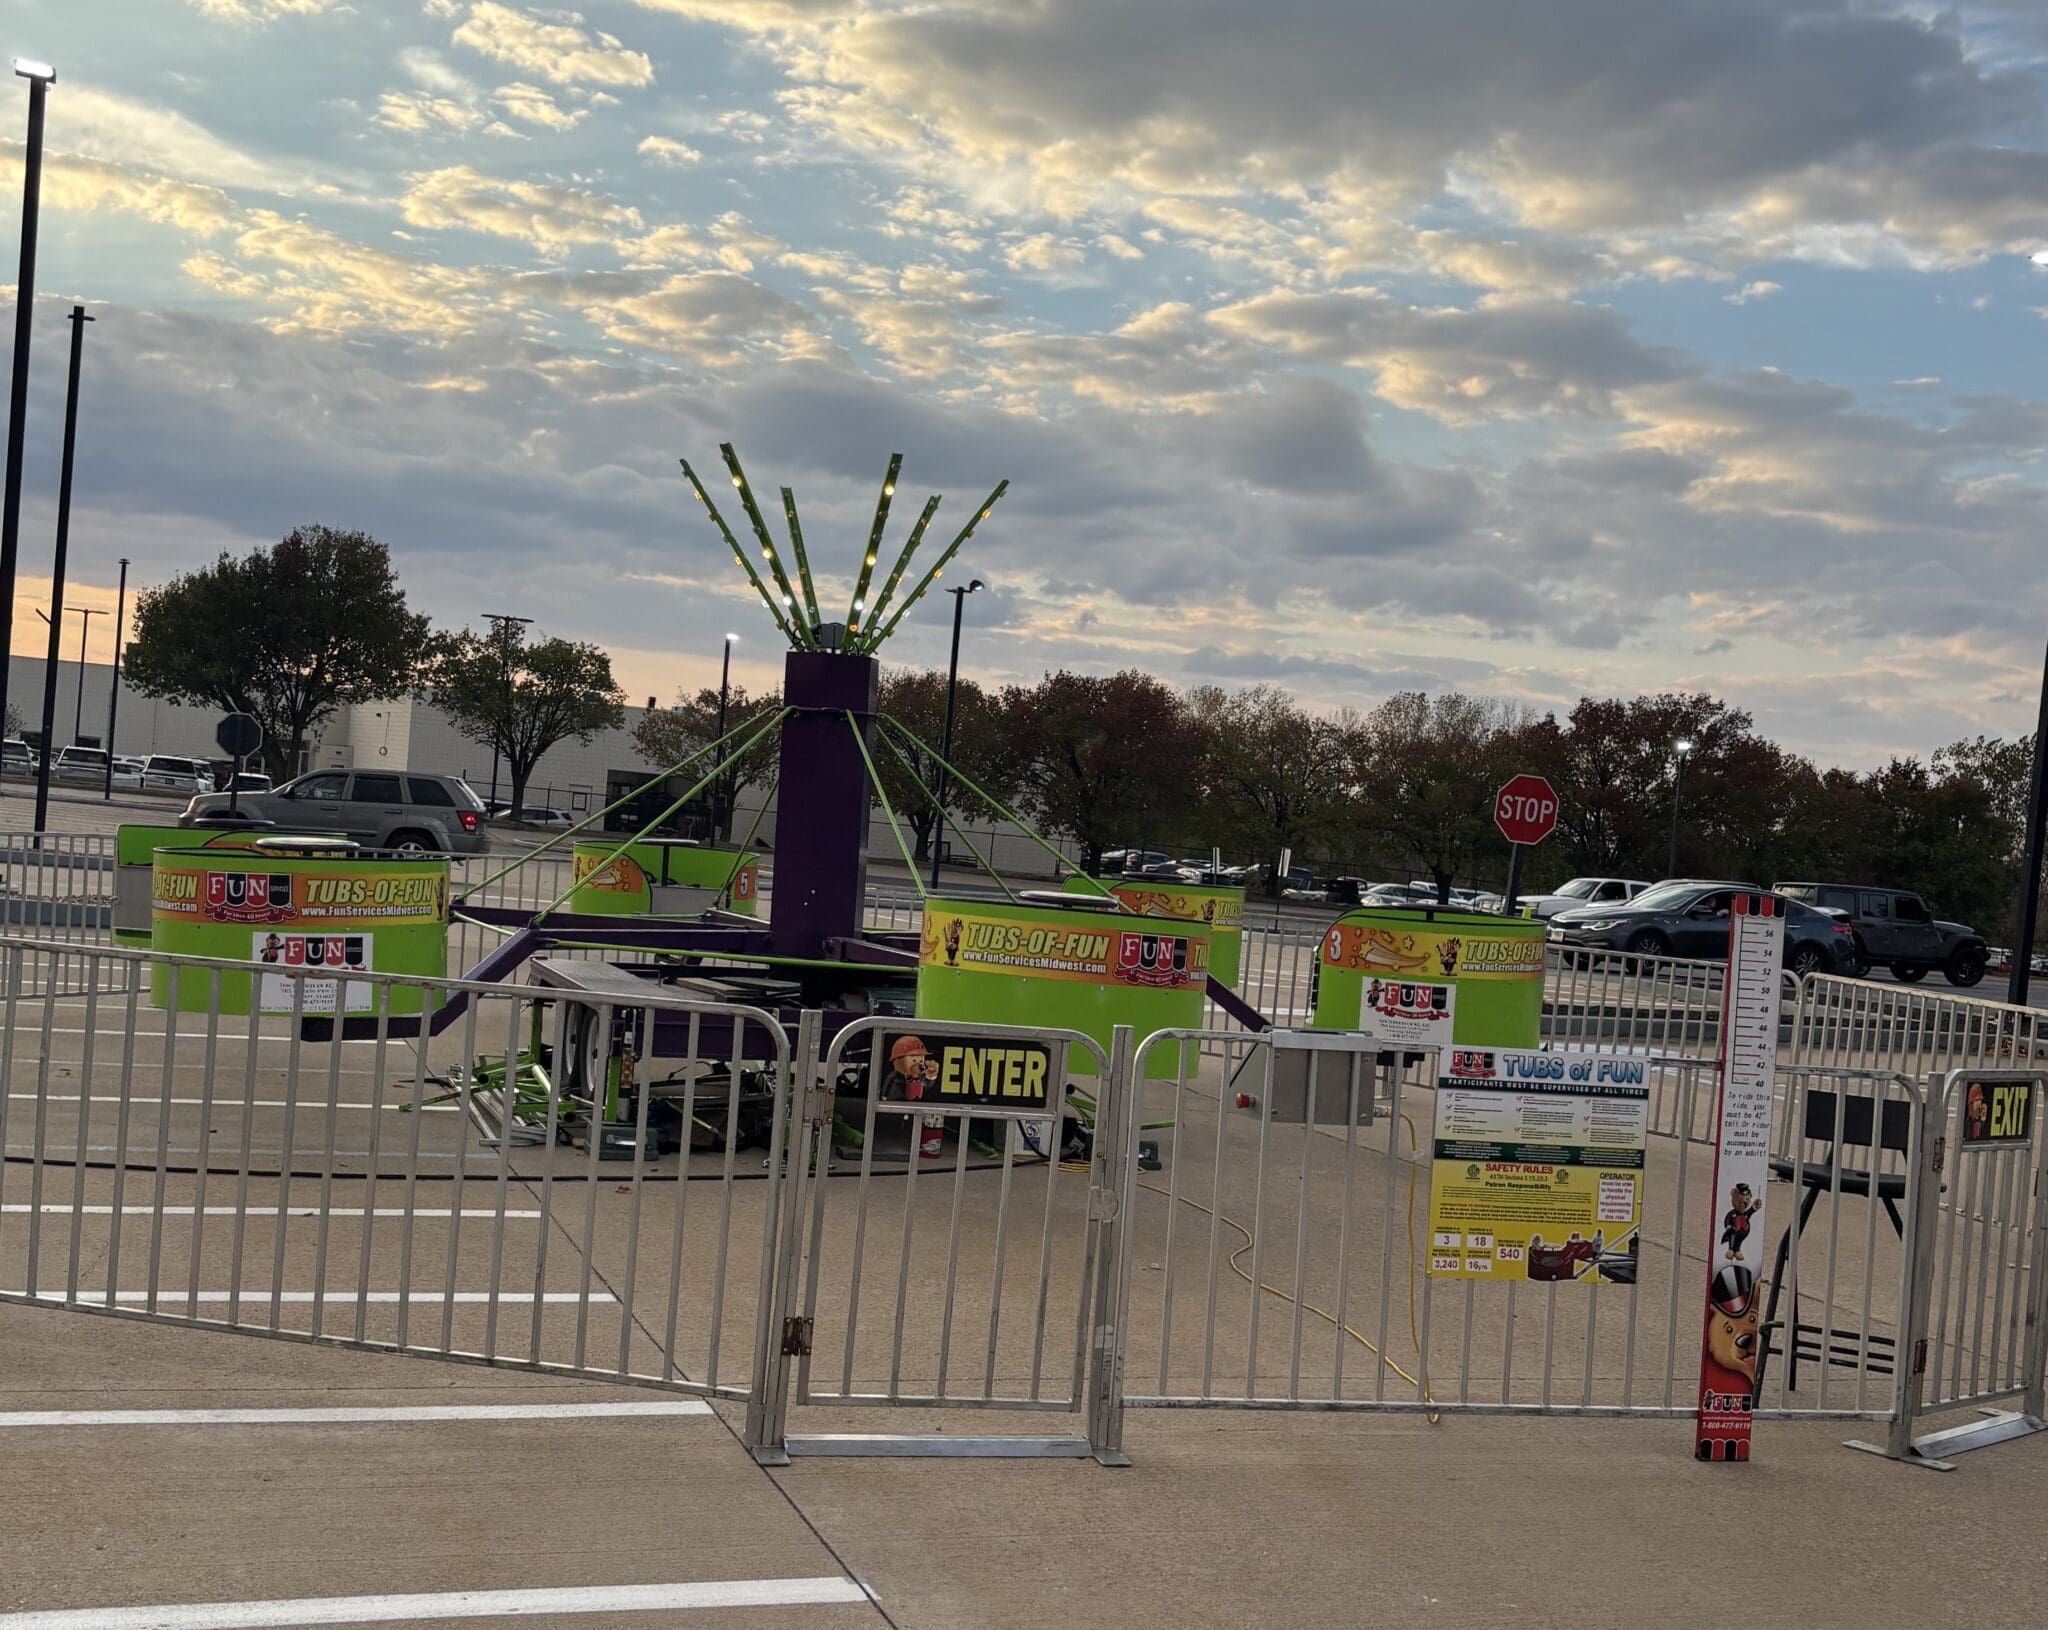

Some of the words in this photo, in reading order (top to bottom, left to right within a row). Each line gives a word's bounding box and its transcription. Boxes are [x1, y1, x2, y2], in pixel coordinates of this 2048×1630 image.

[1499, 794, 1554, 824] STOP
[211, 877, 267, 897] FUN
[739, 872, 748, 896] 5
[306, 879, 433, 904] TUBS-OF-FUN
[1765, 930, 1774, 938] 56
[967, 922, 1110, 961] TUBS-OF-FUN
[1330, 930, 1342, 961] 3
[288, 941, 343, 958] FUN
[1124, 938, 1174, 960] FUN
[962, 950, 1107, 974] www.FunServicesMidwest.com
[1762, 968, 1771, 976] 52
[1387, 985, 1431, 1003] FUN
[1761, 987, 1770, 995] 50
[1760, 1006, 1769, 1014] 48
[1759, 1025, 1768, 1033] 46
[1757, 1043, 1766, 1051] 44
[1453, 1051, 1484, 1066] FUN
[1503, 1054, 1565, 1079] TUBS
[1569, 1058, 1593, 1081] of
[1597, 1061, 1644, 1084] FUN
[1756, 1061, 1765, 1069] 42
[940, 1046, 1047, 1098] ENTER
[1448, 1079, 1504, 1089] PARTICIPANTS
[1507, 1081, 1527, 1090] MUST
[1543, 1083, 1589, 1093] SUPERVISED
[1604, 1087, 1619, 1095] ALL
[1622, 1088, 1644, 1096] TIMES
[1755, 1080, 1764, 1088] 40
[1990, 1086, 2029, 1137] EXIT
[1485, 1163, 1522, 1174] SAFETY
[1523, 1165, 1553, 1175] RULES
[1600, 1172, 1636, 1180] OPERATOR
[1443, 1235, 1450, 1245] 3
[1474, 1236, 1487, 1246] 18
[1500, 1249, 1520, 1259] 540
[1434, 1259, 1458, 1269] 3,240
[1714, 1397, 1741, 1408] FUN
[1702, 1422, 1751, 1430] 1-800-477-9119
